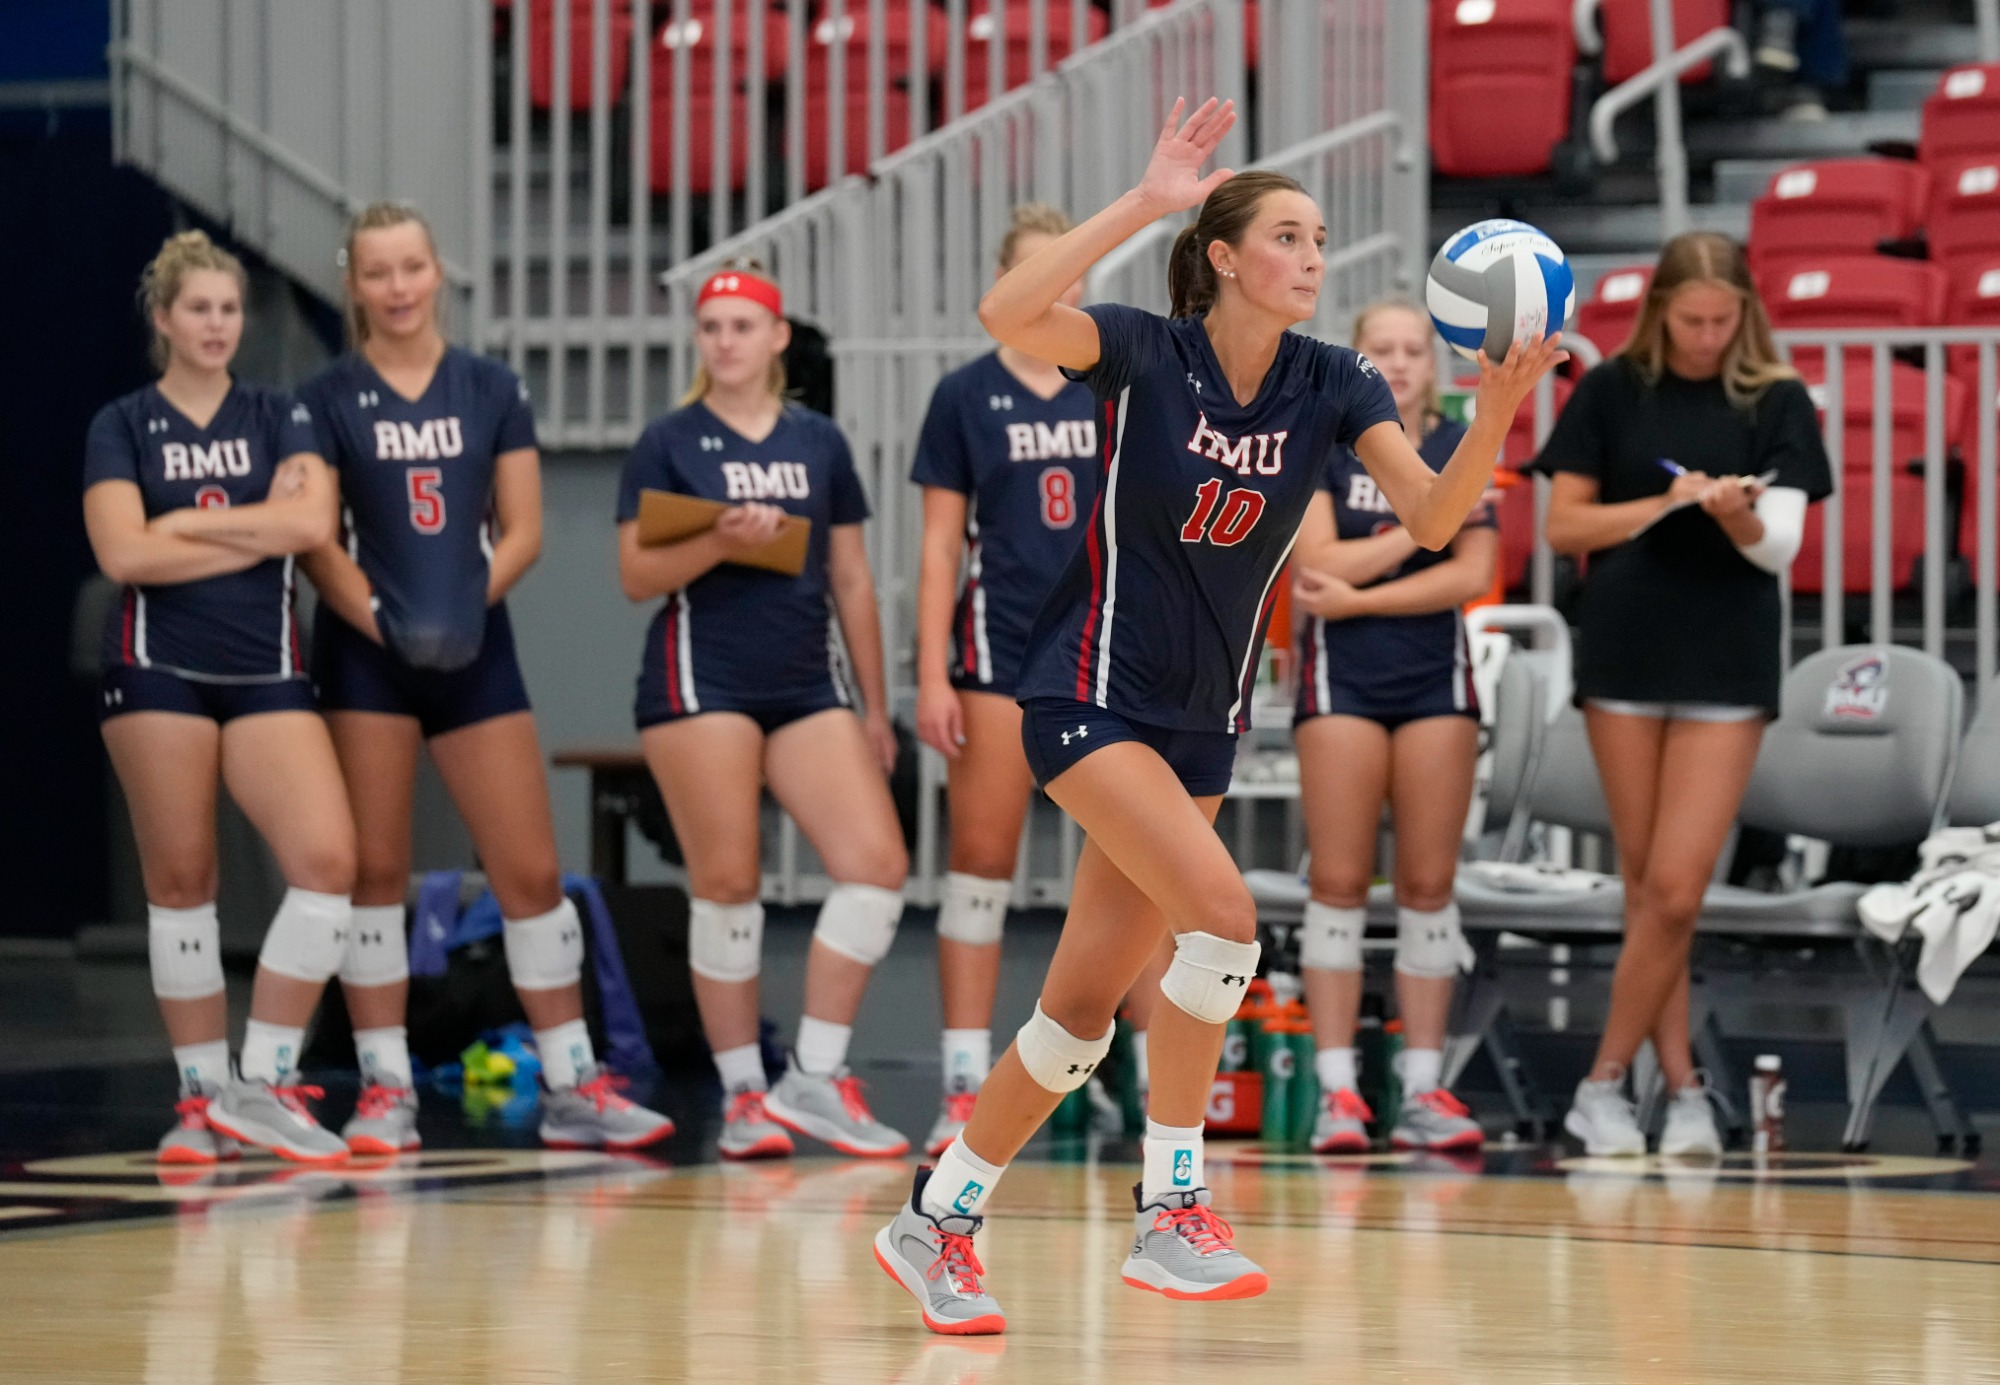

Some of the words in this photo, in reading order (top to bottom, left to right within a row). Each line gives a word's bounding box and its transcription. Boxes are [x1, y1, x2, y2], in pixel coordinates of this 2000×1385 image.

[162, 438, 252, 481] RMU
[374, 416, 463, 460] RMU
[1006, 420, 1097, 461] RMU
[1187, 410, 1288, 476] RMU
[406, 467, 446, 535] 5
[721, 461, 810, 499] RMU
[1038, 466, 1077, 530] 8
[1180, 477, 1266, 547] 10
[1206, 1080, 1235, 1122] G
